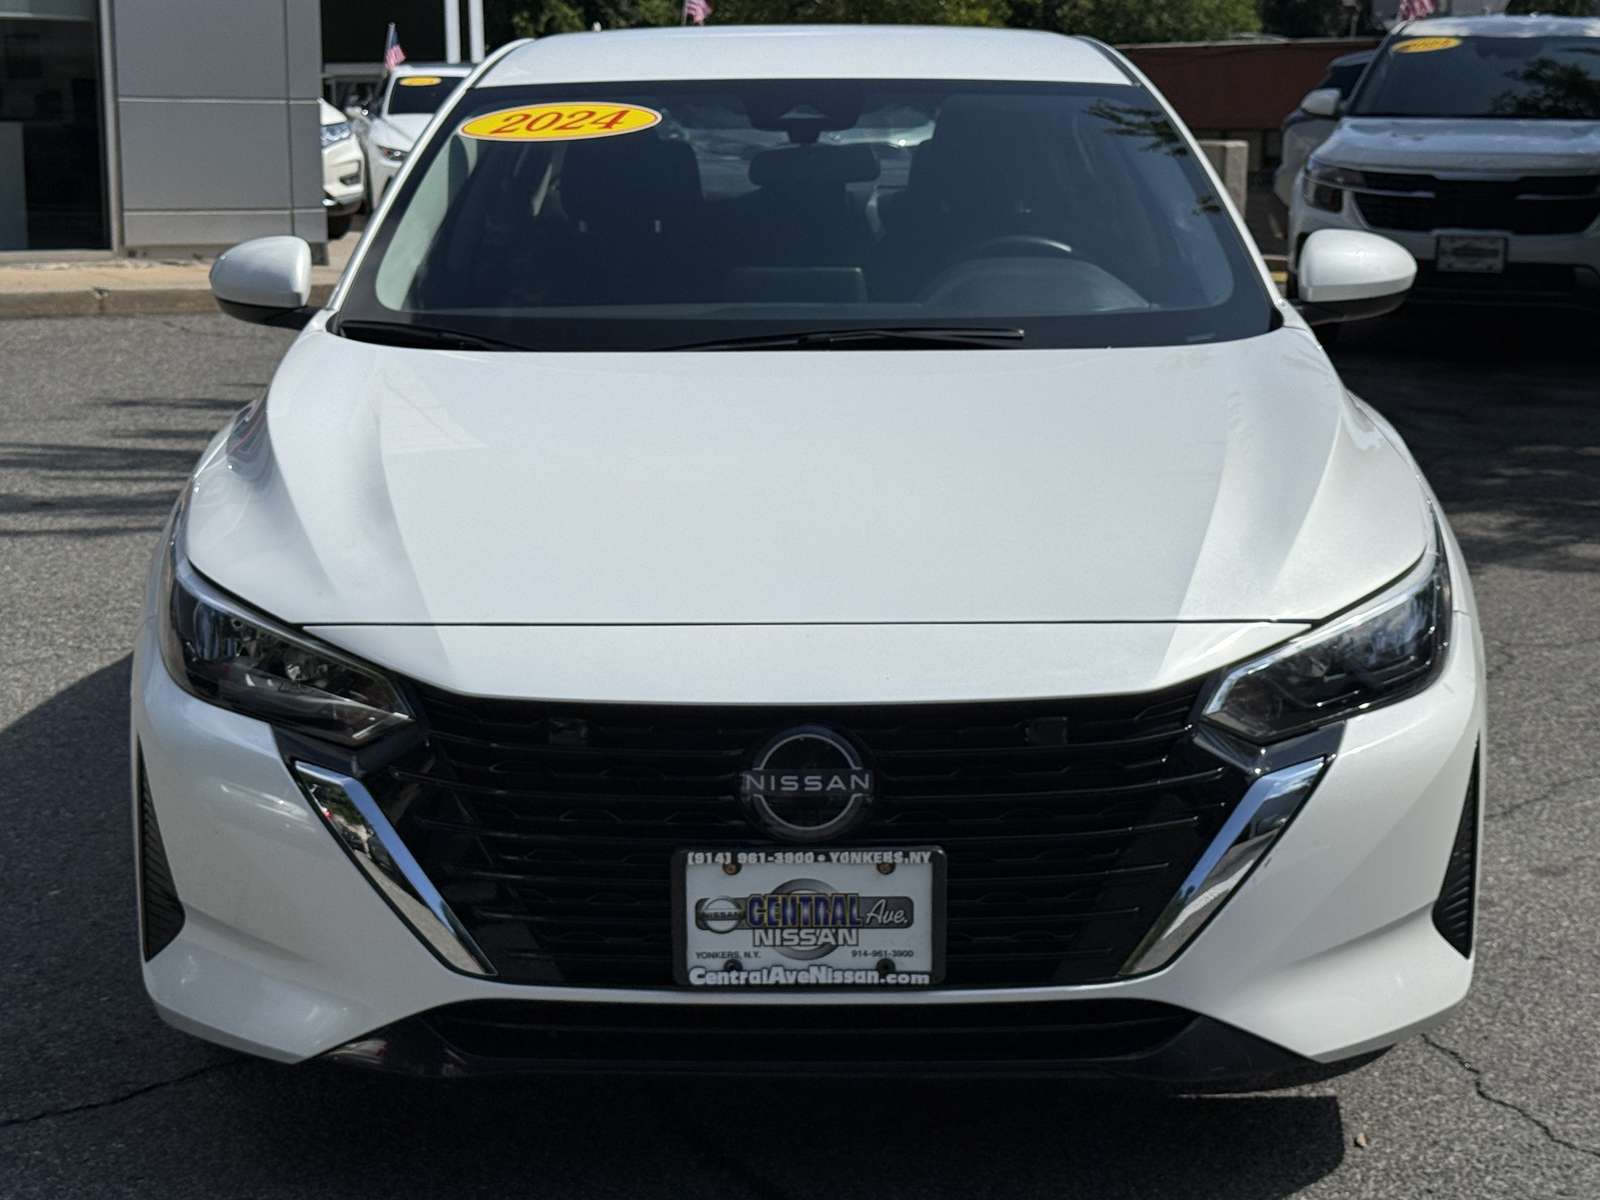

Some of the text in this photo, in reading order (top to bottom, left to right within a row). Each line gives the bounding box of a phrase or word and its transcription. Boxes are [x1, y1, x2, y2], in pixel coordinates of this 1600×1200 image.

[489, 110, 631, 135] 2024
[746, 774, 869, 791] NISSAN
[737, 852, 815, 864] 961-3900
[703, 911, 742, 919] NISSAN
[747, 894, 908, 928] CENTRAL Ave.
[753, 928, 859, 947] NISSAN
[695, 951, 742, 959] YONKERS,
[851, 949, 914, 957] 914-961-3900
[689, 965, 930, 985] CentralAveNissan.com
